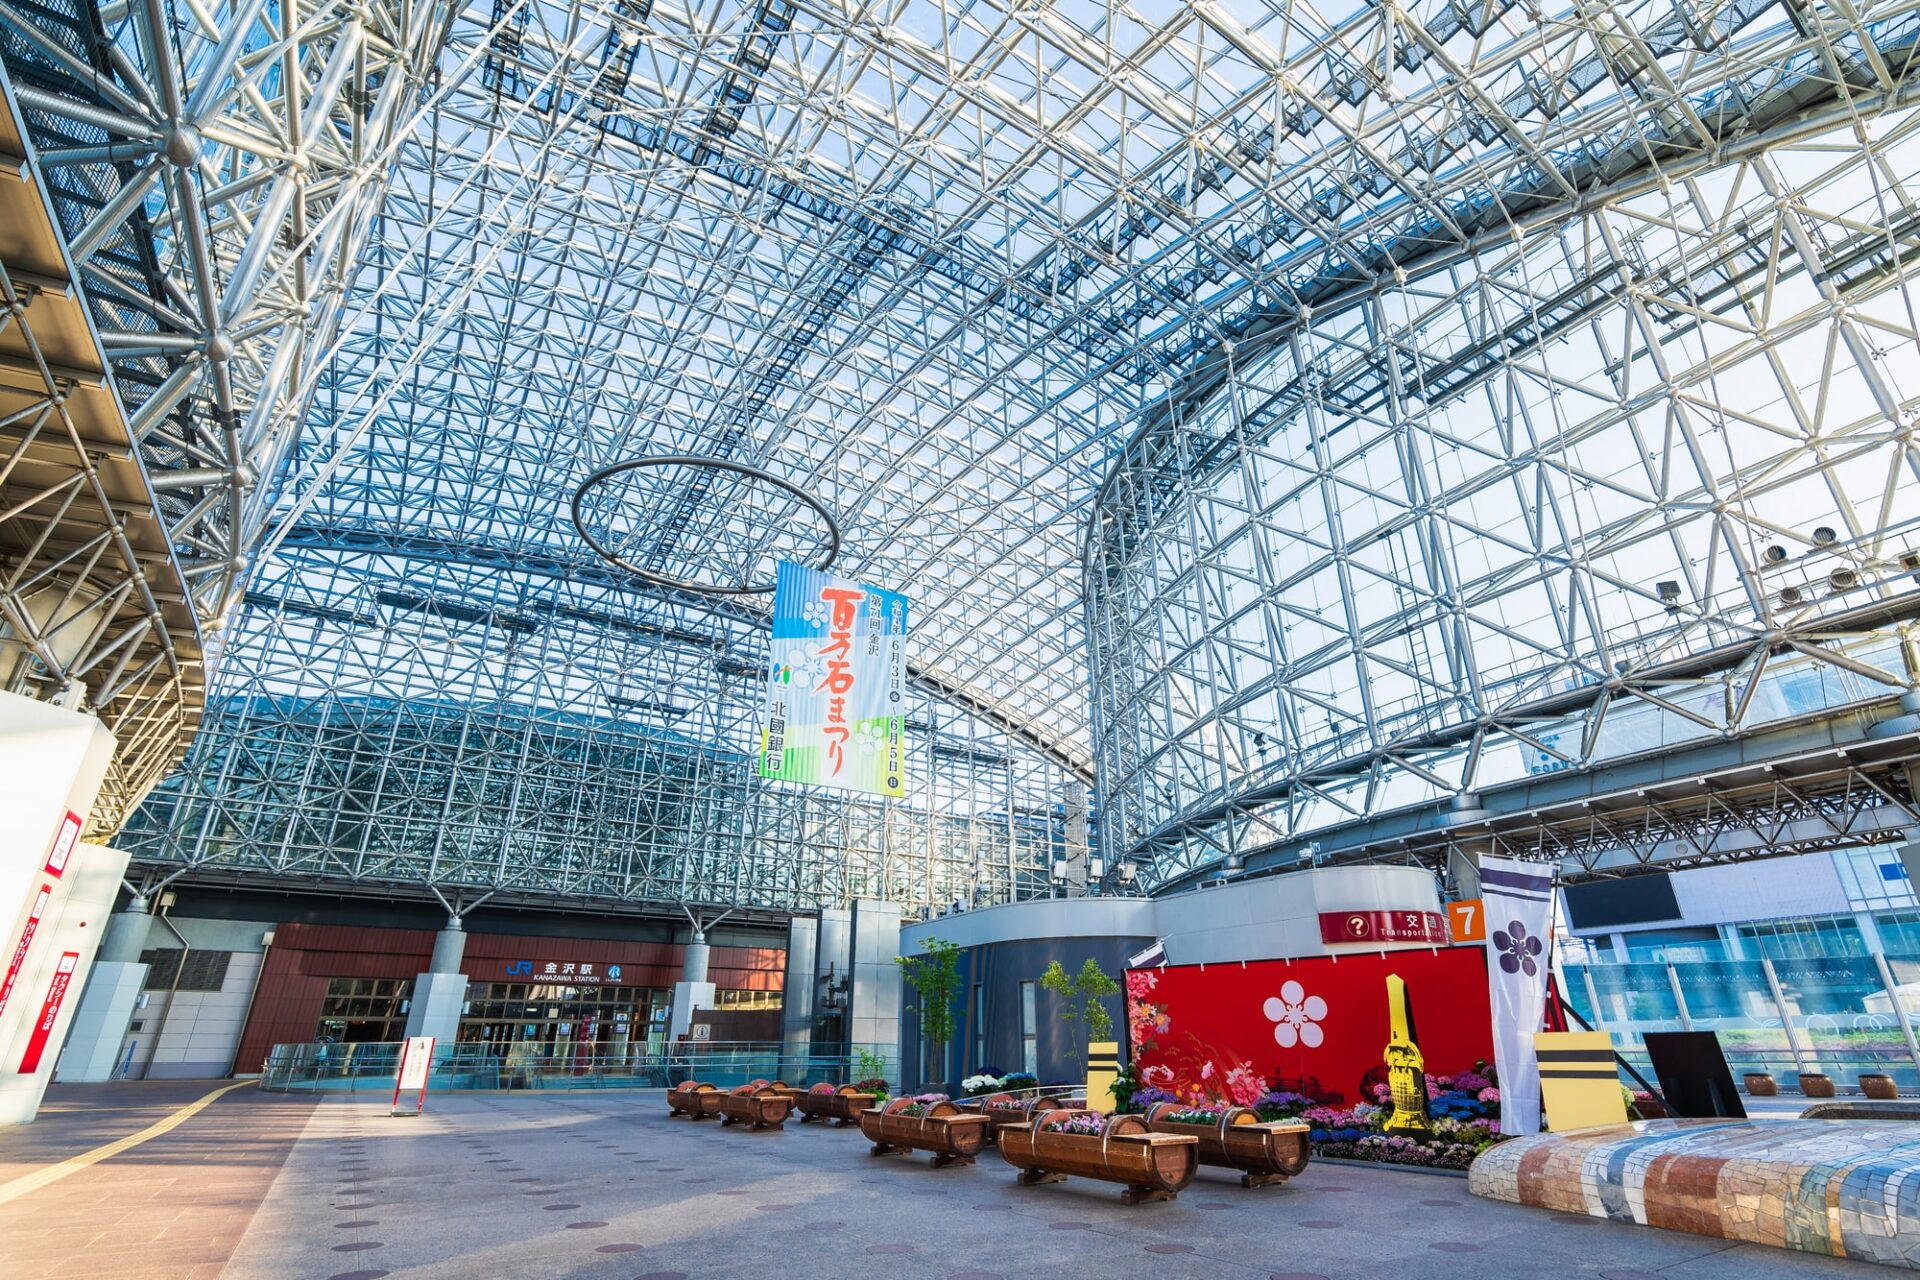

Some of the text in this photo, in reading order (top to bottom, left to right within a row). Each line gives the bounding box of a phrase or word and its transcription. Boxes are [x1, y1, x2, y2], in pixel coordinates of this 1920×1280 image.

[815, 587, 866, 777] 百万石まつり
[766, 701, 786, 772] 北國銀行
[1456, 906, 1475, 935] 7
[505, 960, 533, 976] JR
[533, 974, 572, 982] KANAZAWA
[574, 975, 600, 983] STATION
[544, 962, 593, 975] 金沢駅
